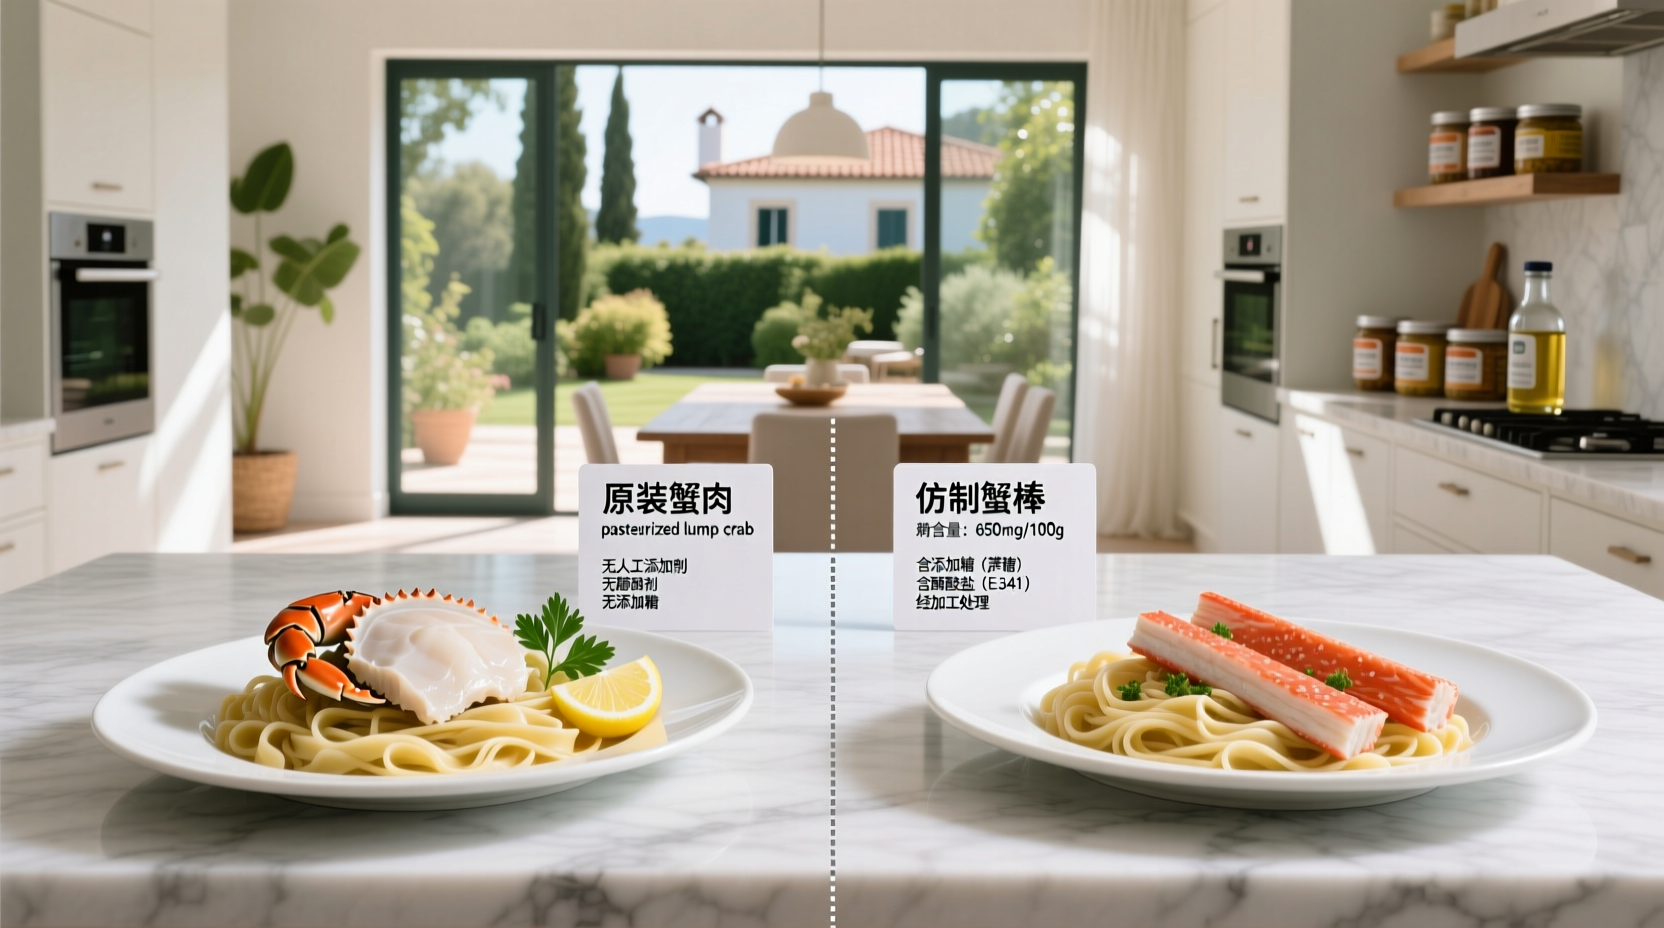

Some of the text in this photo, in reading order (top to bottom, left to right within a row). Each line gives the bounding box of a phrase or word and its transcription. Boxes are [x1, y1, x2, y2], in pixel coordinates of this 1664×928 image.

[603, 481, 732, 516] 原装蟹肉
[916, 480, 1045, 515] 仿制蟹棒
[684, 520, 720, 540] lump
[723, 520, 755, 537] crab
